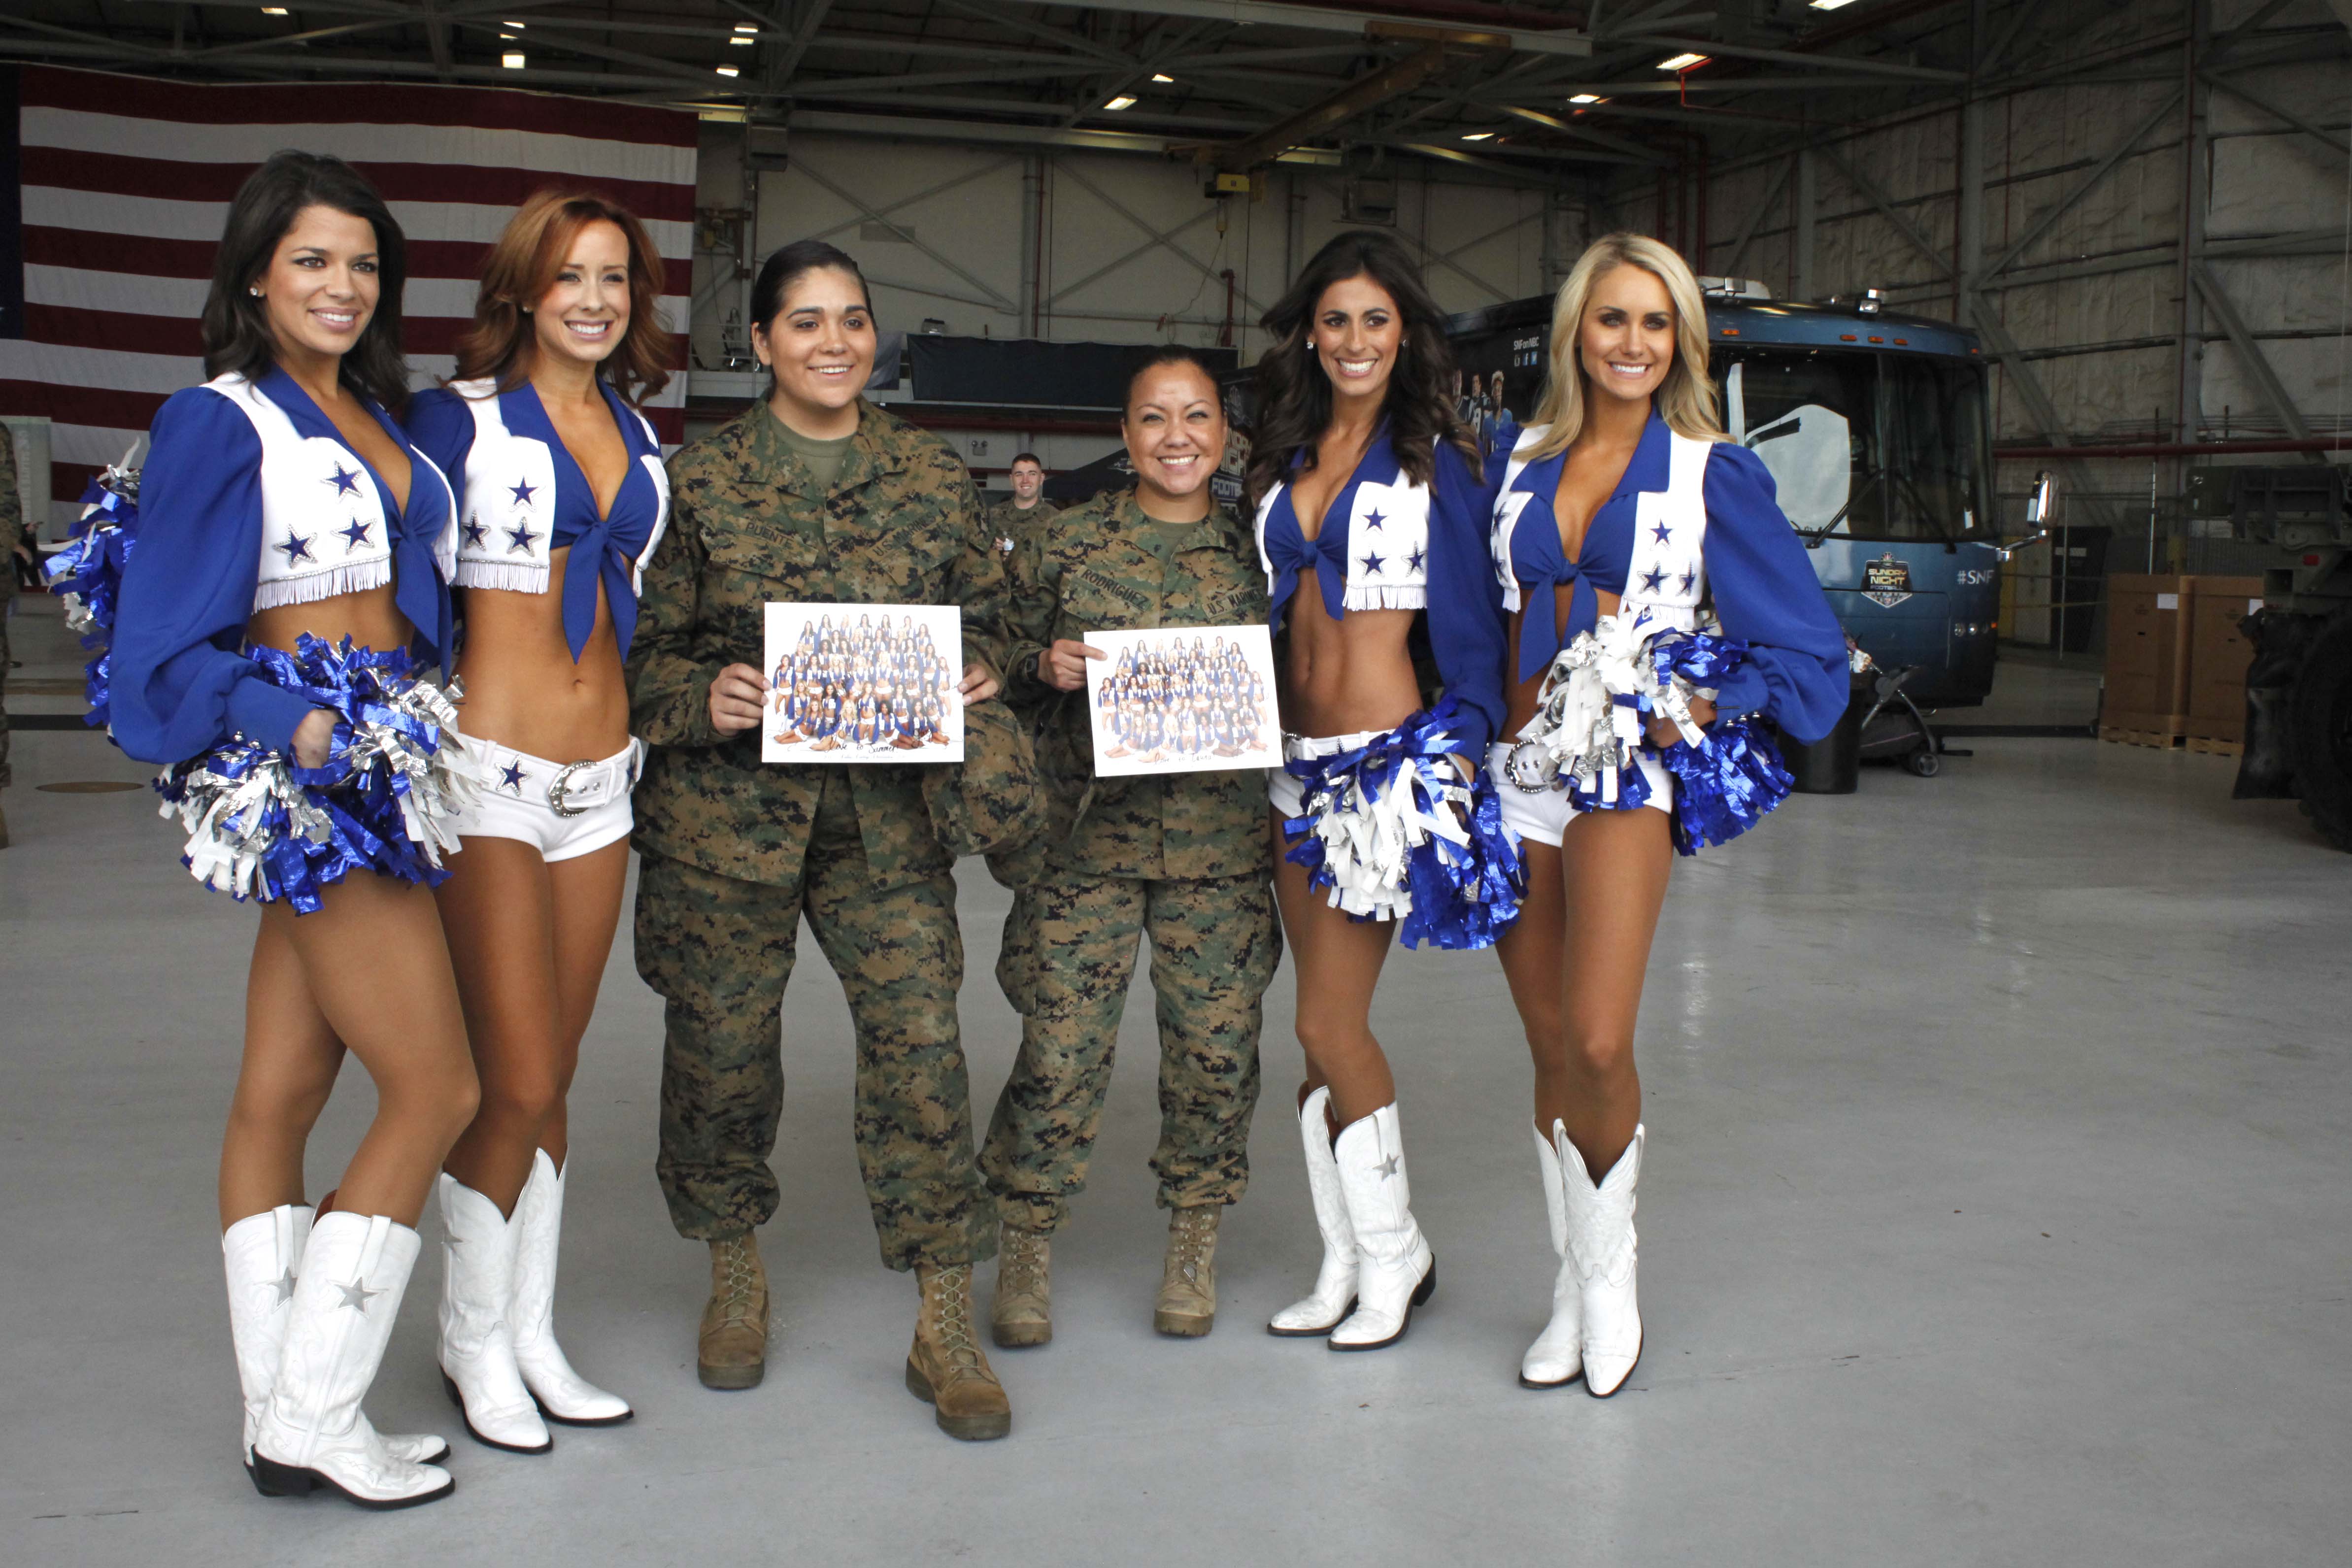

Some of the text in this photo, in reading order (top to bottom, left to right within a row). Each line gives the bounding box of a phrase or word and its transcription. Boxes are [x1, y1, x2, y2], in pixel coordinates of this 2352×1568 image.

[1212, 477, 1243, 497] FOOTB
[745, 521, 795, 550] PUENTE
[892, 513, 937, 545] MARINES
[1870, 575, 1906, 585] NIGHT
[1957, 569, 1995, 585] #SNF
[1081, 568, 1150, 609] RODRIGUEZ
[1227, 588, 1265, 608] MARINES
